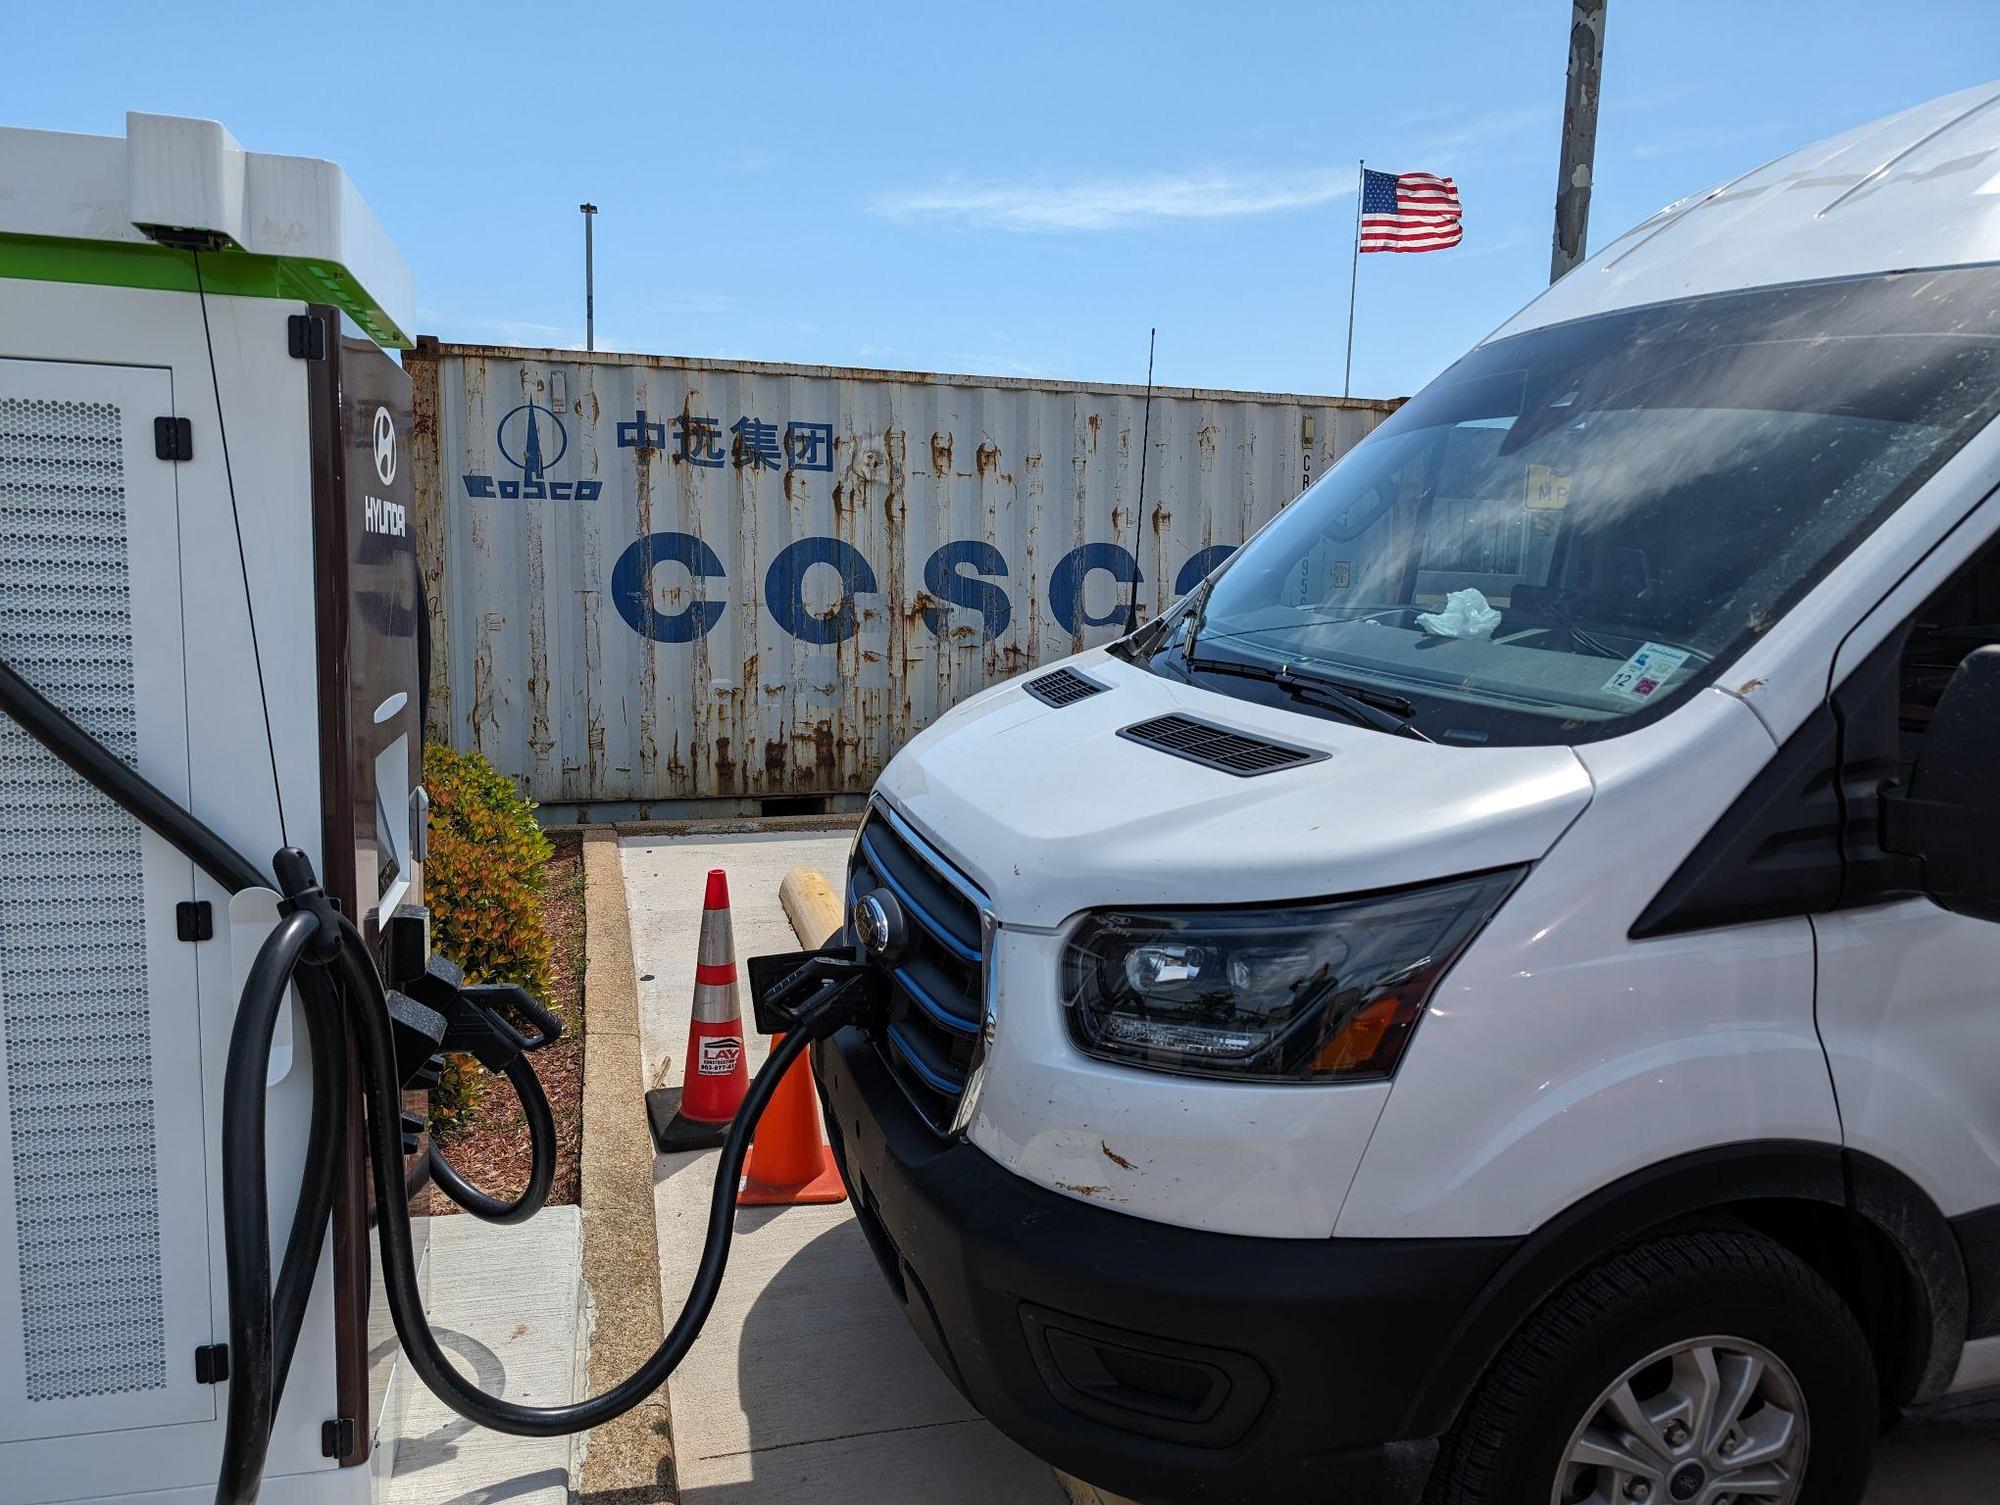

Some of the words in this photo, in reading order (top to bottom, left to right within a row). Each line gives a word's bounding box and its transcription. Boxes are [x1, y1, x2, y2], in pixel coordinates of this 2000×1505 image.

[616, 410, 834, 472] 中远集团
[1302, 454, 1312, 491] CB
[1612, 672, 1632, 687] 12
[704, 1049, 740, 1059] LAY
